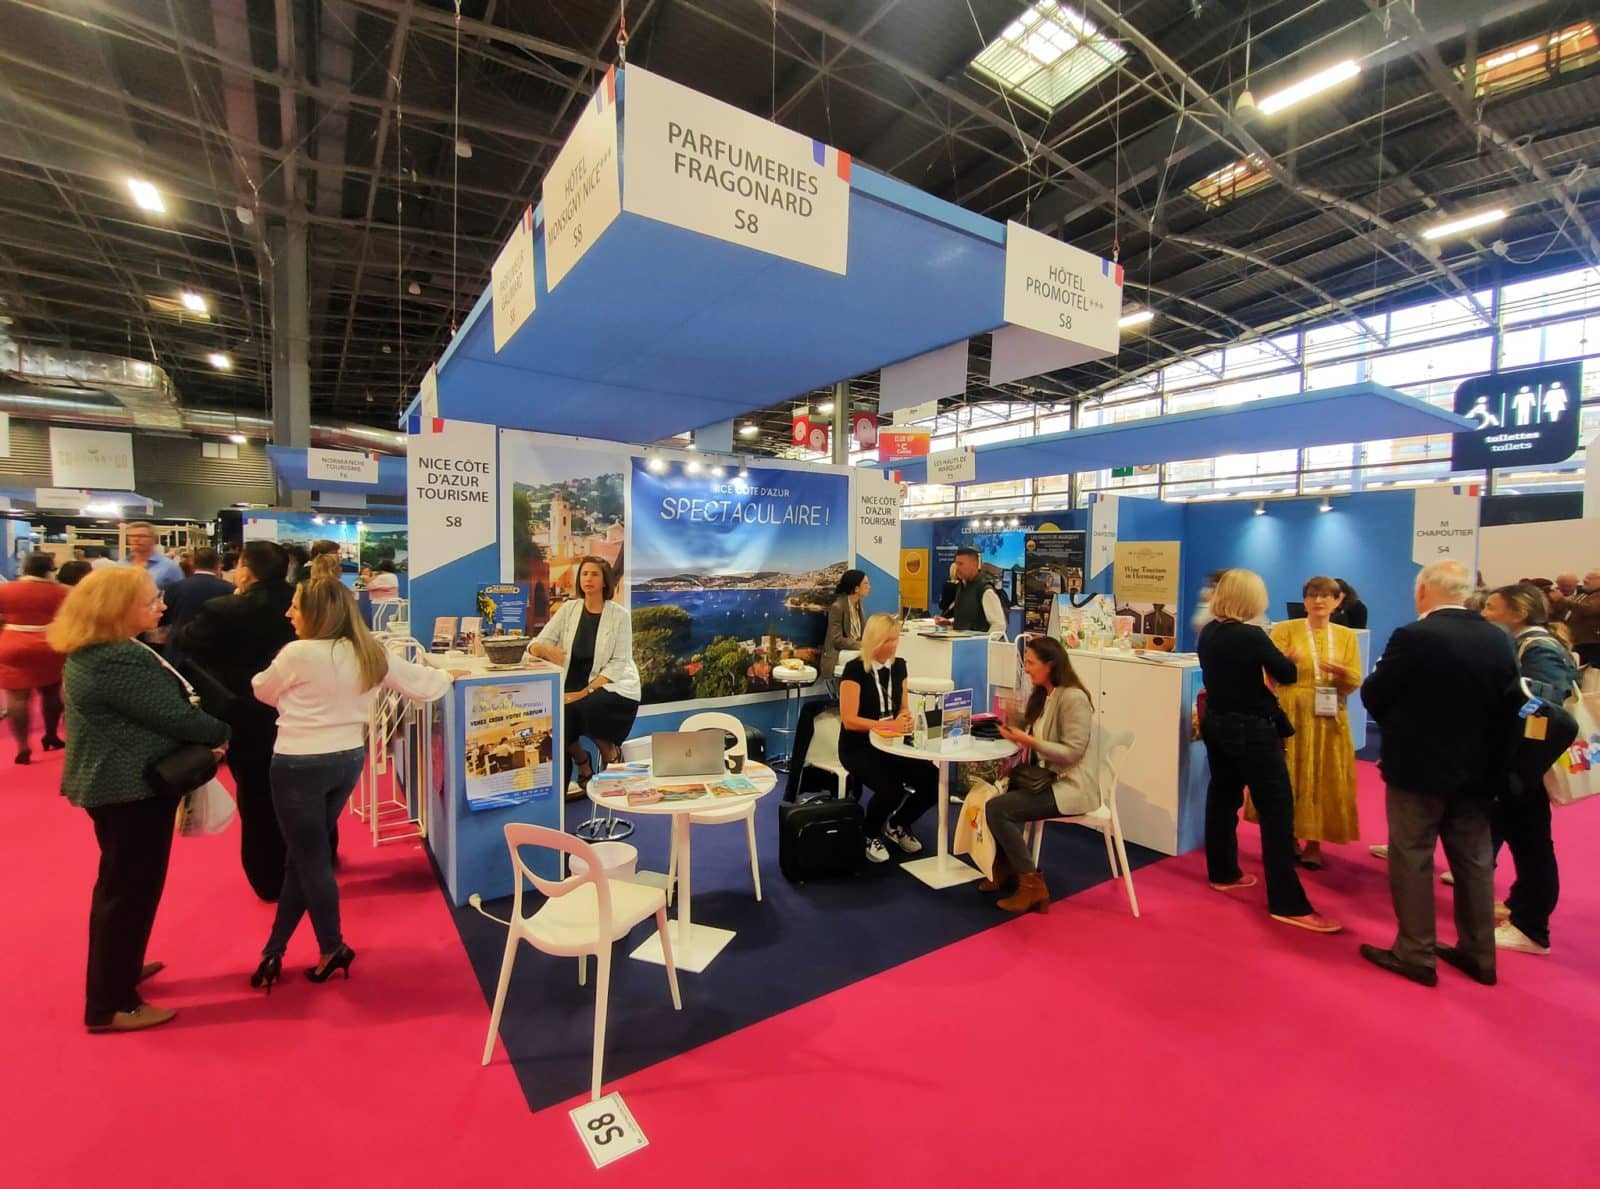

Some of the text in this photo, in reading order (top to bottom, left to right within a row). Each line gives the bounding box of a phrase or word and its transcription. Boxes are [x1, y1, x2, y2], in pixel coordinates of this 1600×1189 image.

[668, 121, 818, 196] PARFUMERIES
[564, 156, 587, 200] HÔTEL
[674, 152, 812, 217] FRAGONARD
[734, 208, 759, 234] S8
[573, 223, 583, 248] S8
[1049, 265, 1085, 292] HÔTEL
[1059, 312, 1072, 329] S8
[1486, 432, 1541, 443] toilettes
[1492, 442, 1533, 452] toilets
[418, 457, 489, 474] NICE CÔTE
[427, 472, 479, 487] D'AZUR
[416, 487, 489, 503] TOURISME
[861, 495, 897, 506] NICE CÔTE
[446, 515, 462, 527] S8
[860, 516, 897, 526] TOURISME
[1440, 520, 1449, 528] M
[1416, 529, 1474, 537] CHAPOUTIER
[1141, 566, 1167, 574] Tourism
[587, 1113, 625, 1146] S8
